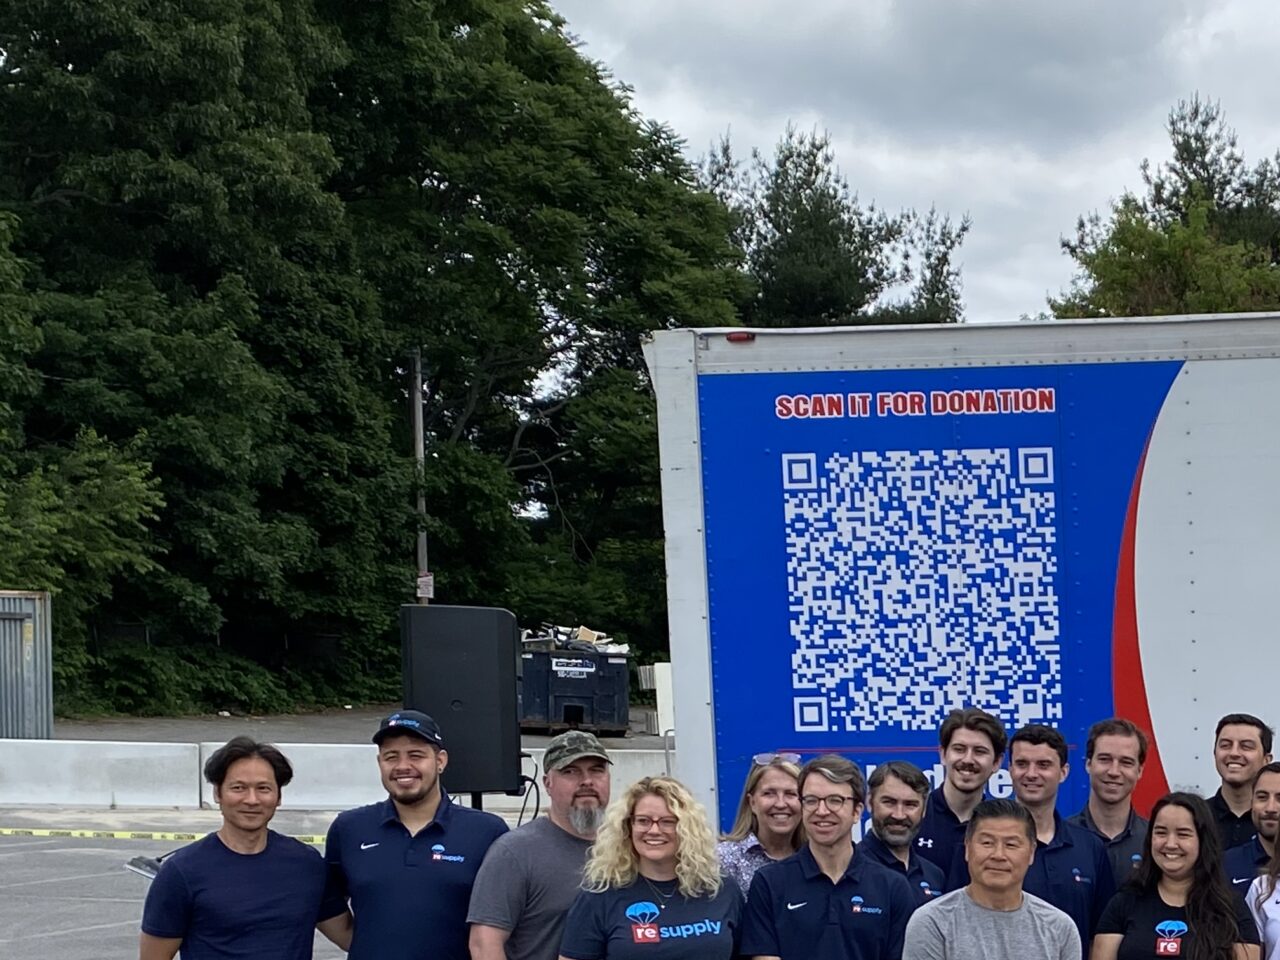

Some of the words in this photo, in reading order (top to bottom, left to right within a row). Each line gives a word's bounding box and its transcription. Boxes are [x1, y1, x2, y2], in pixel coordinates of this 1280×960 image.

[776, 394, 844, 419] SCAN
[848, 392, 872, 417] IT
[877, 391, 926, 416] FOR
[931, 388, 1055, 415] DONATION
[660, 919, 722, 938] supply
[1160, 942, 1178, 952] re
